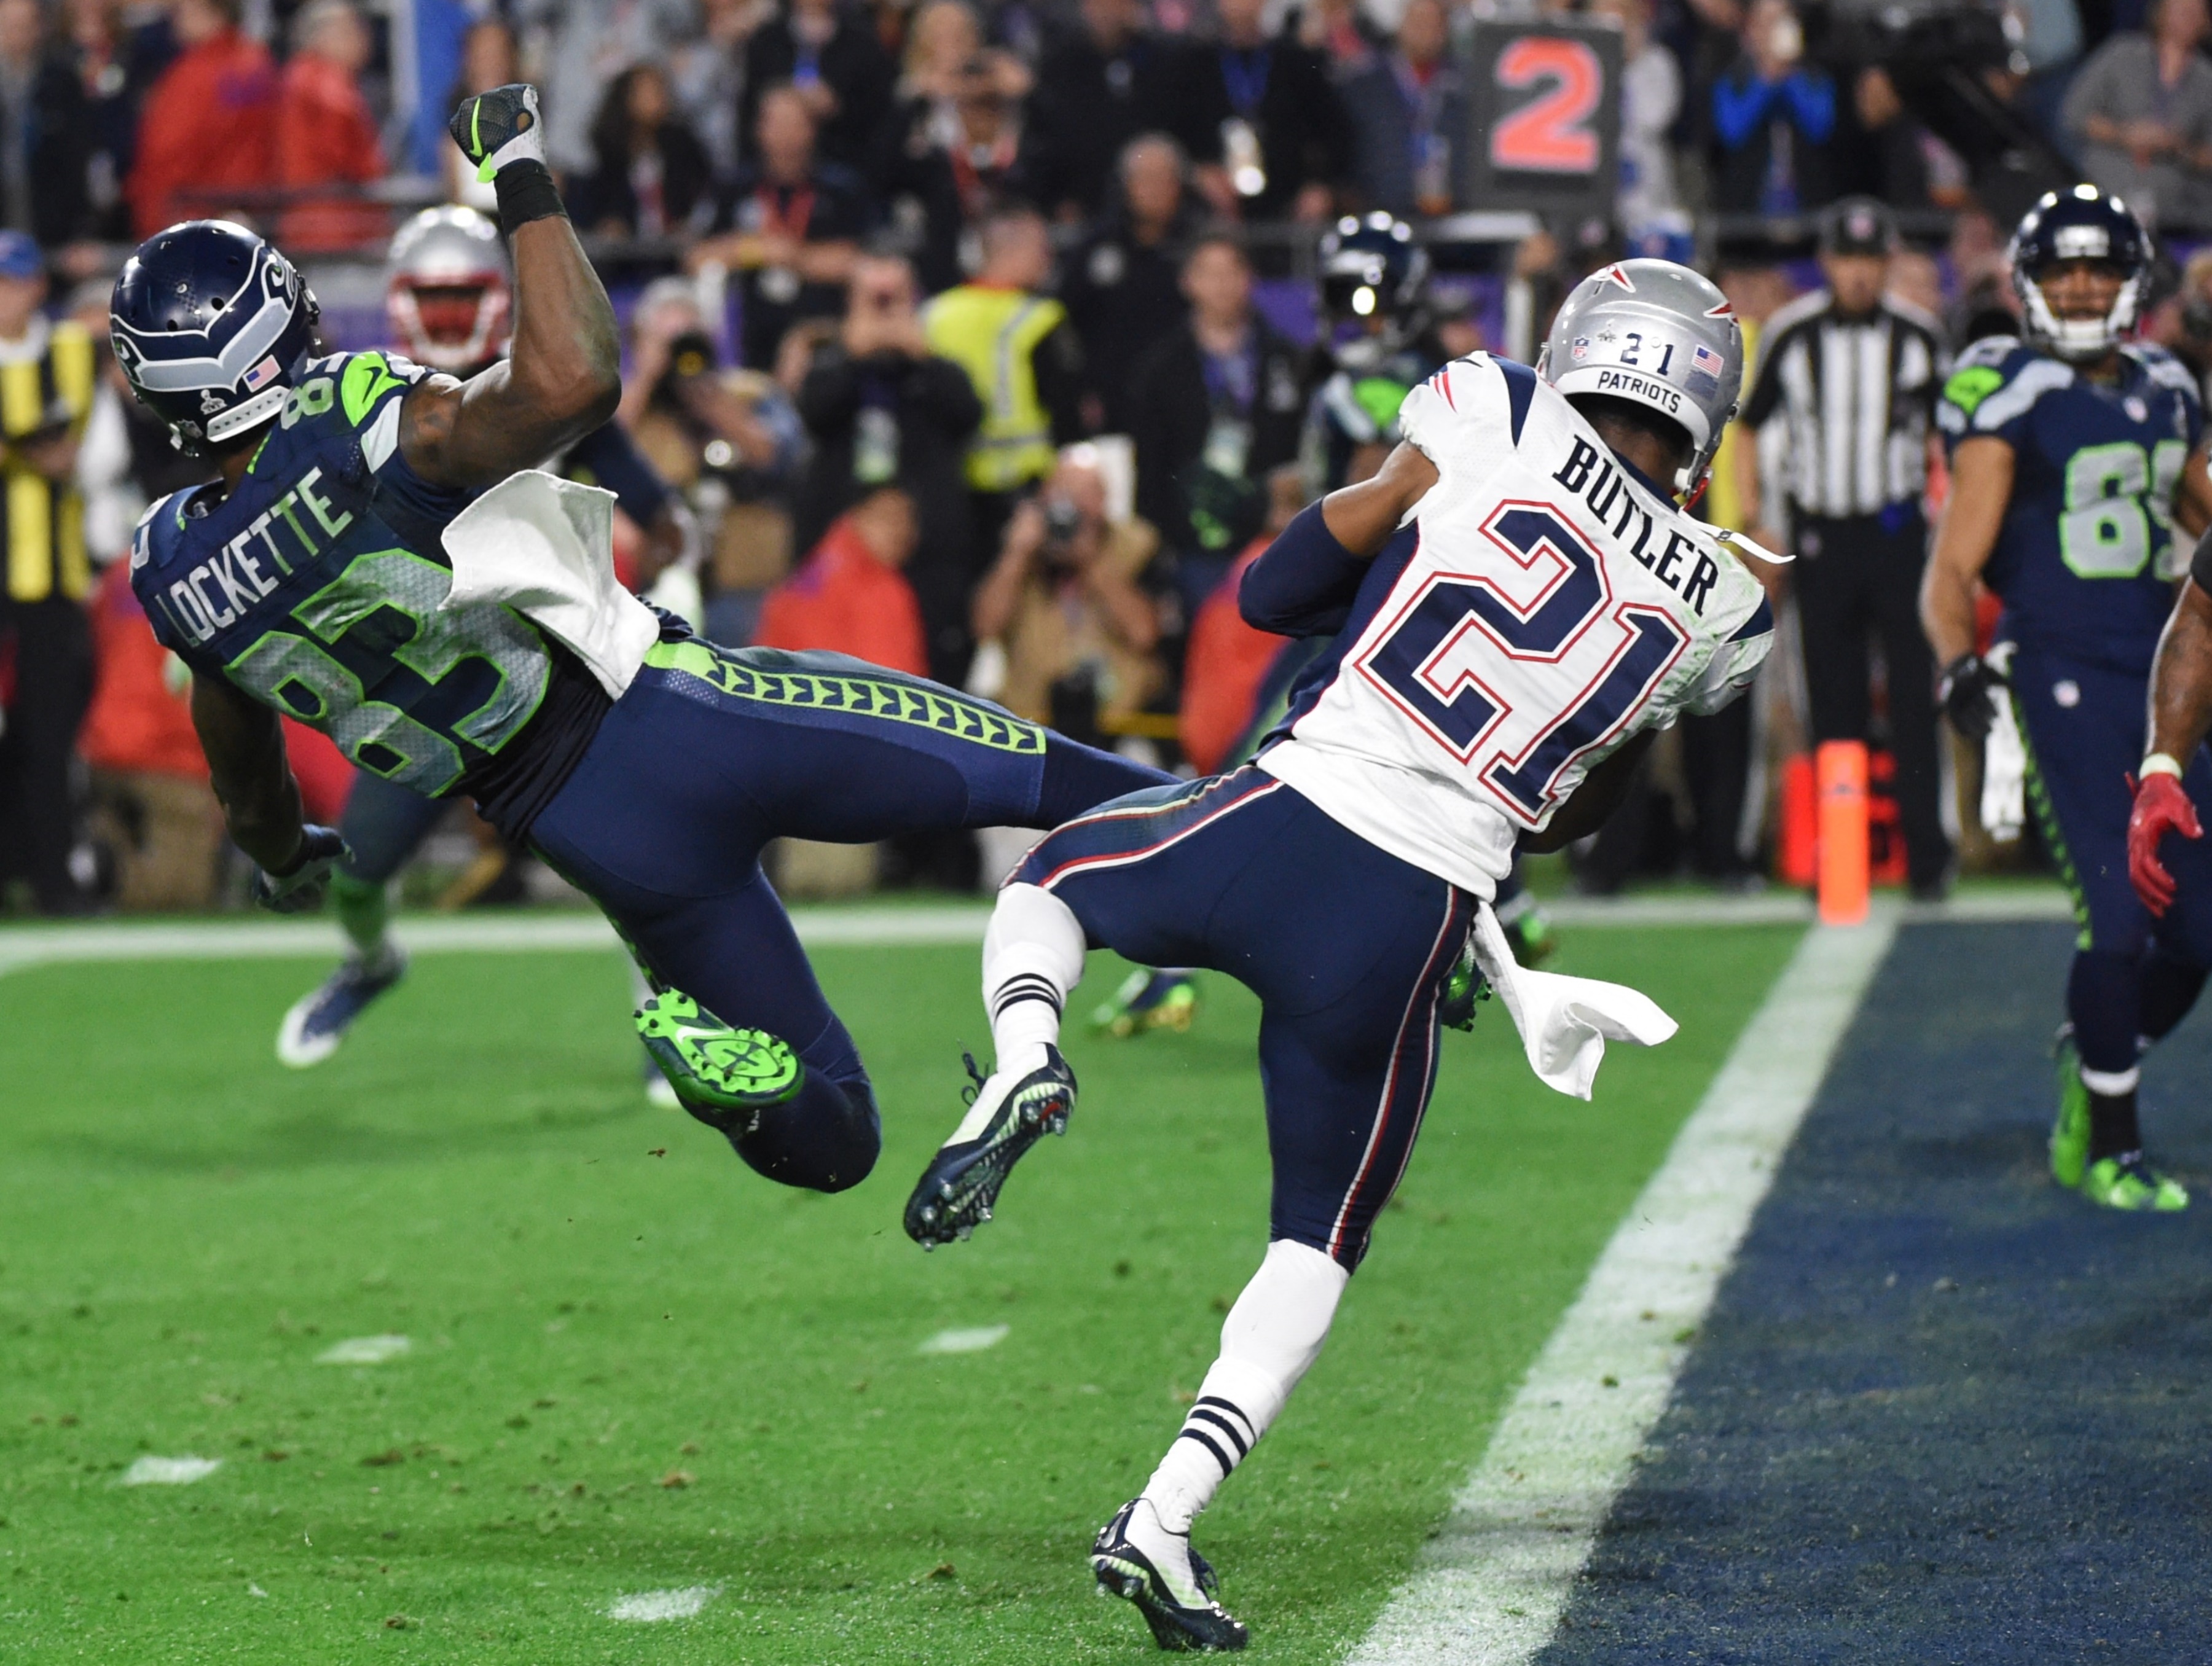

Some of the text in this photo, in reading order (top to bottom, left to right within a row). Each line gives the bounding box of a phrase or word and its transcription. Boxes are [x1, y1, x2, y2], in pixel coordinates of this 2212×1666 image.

[1491, 35, 1601, 173] 2
[1597, 370, 1681, 414] PATRIOTS
[1620, 333, 1673, 375] 21
[155, 466, 354, 647] LOCKETTE
[1553, 434, 1719, 617] BUTLER
[223, 548, 552, 798] 83
[1354, 499, 1692, 824] 21
